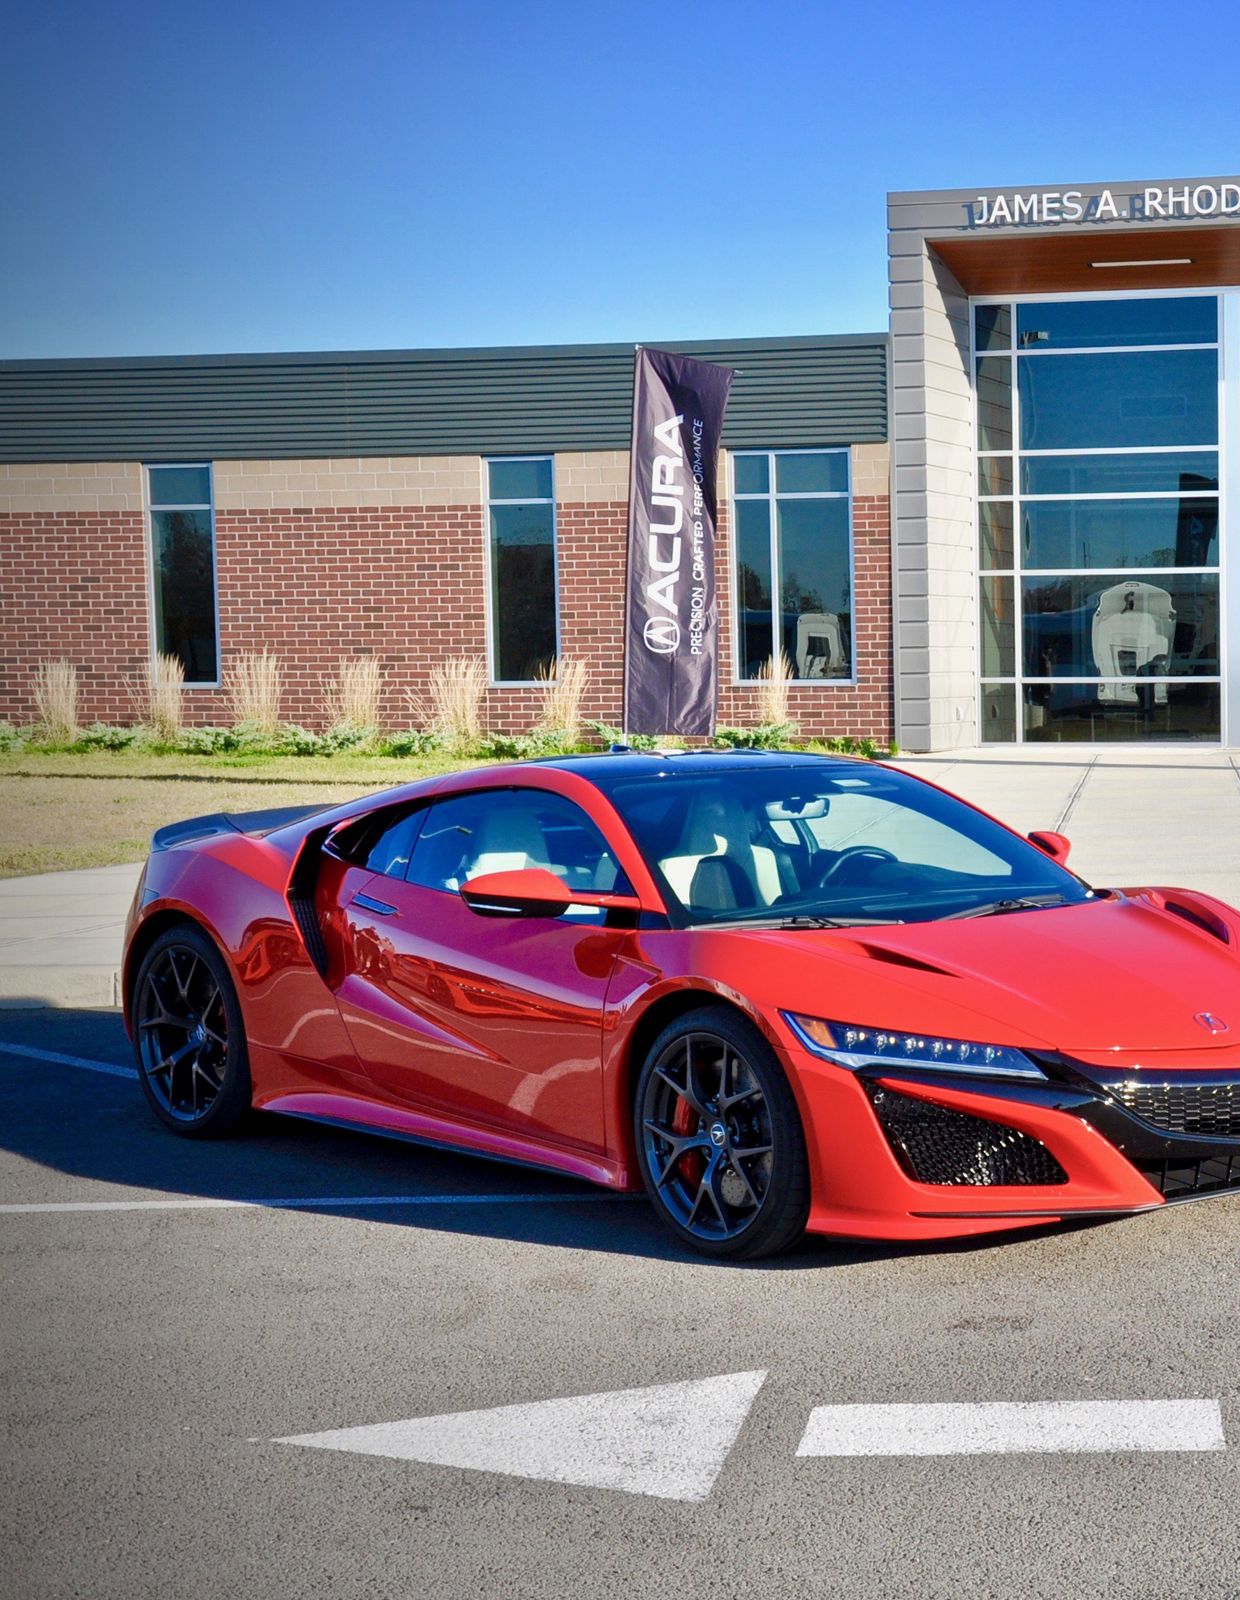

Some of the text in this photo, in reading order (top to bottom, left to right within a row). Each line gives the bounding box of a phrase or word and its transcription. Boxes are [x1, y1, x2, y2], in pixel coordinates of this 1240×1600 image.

[975, 191, 1082, 225] JAMES
[1095, 190, 1128, 219] A.
[646, 413, 685, 616] ACURA
[690, 418, 705, 656] PRECISION CRAFTED PERFORMANCE
